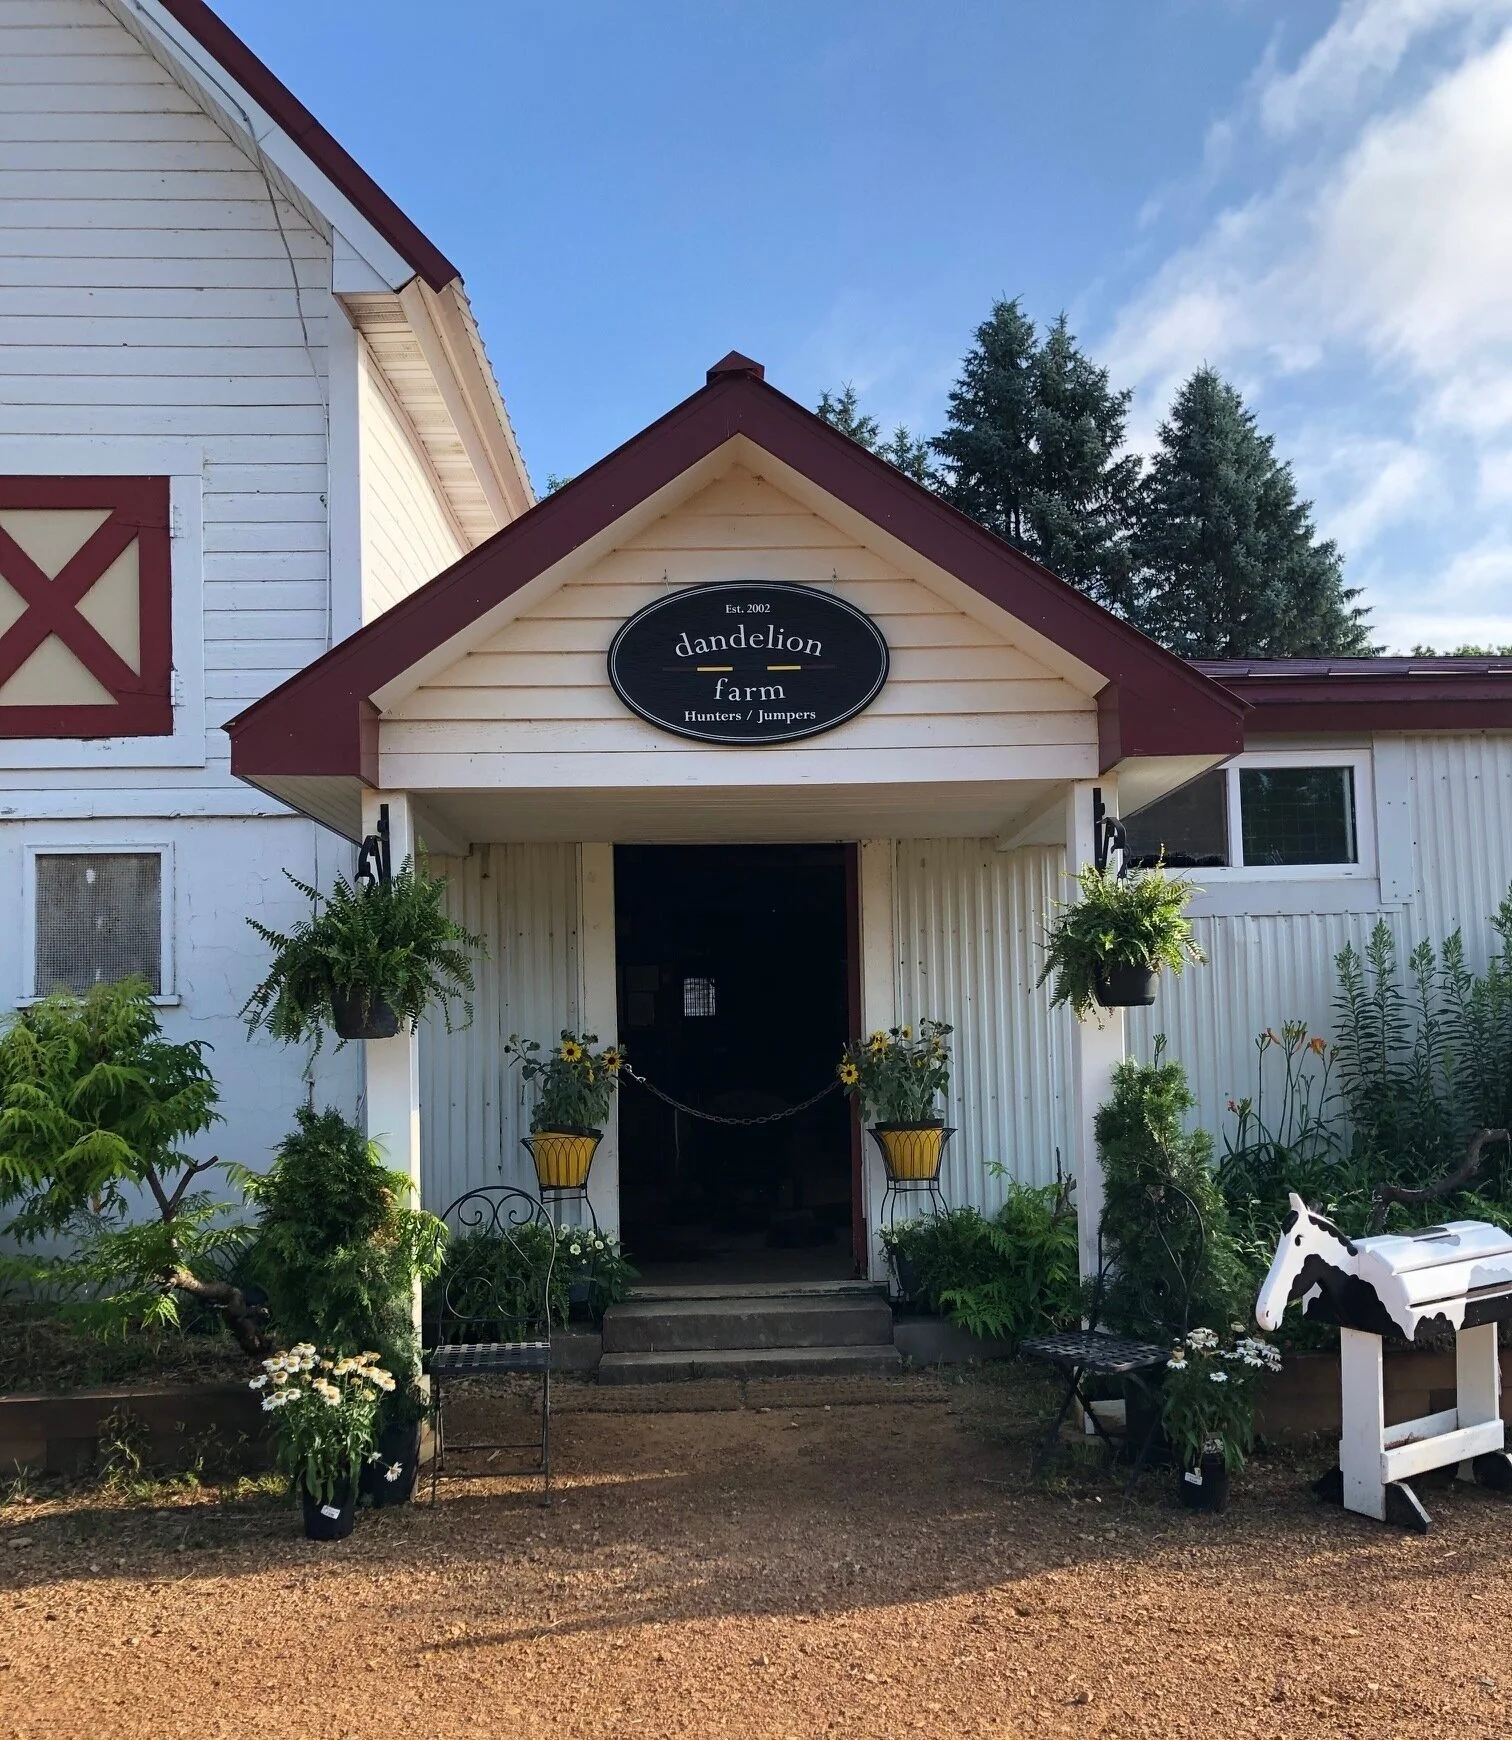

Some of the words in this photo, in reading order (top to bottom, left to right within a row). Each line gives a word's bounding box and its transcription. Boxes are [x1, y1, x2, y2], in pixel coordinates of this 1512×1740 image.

[725, 604, 744, 614] Est.
[746, 603, 771, 614] 2002
[675, 624, 822, 657] dandelion
[713, 677, 786, 701] farm
[684, 710, 742, 722] Hunters
[746, 709, 753, 721] /
[756, 709, 817, 724] Jumpers
